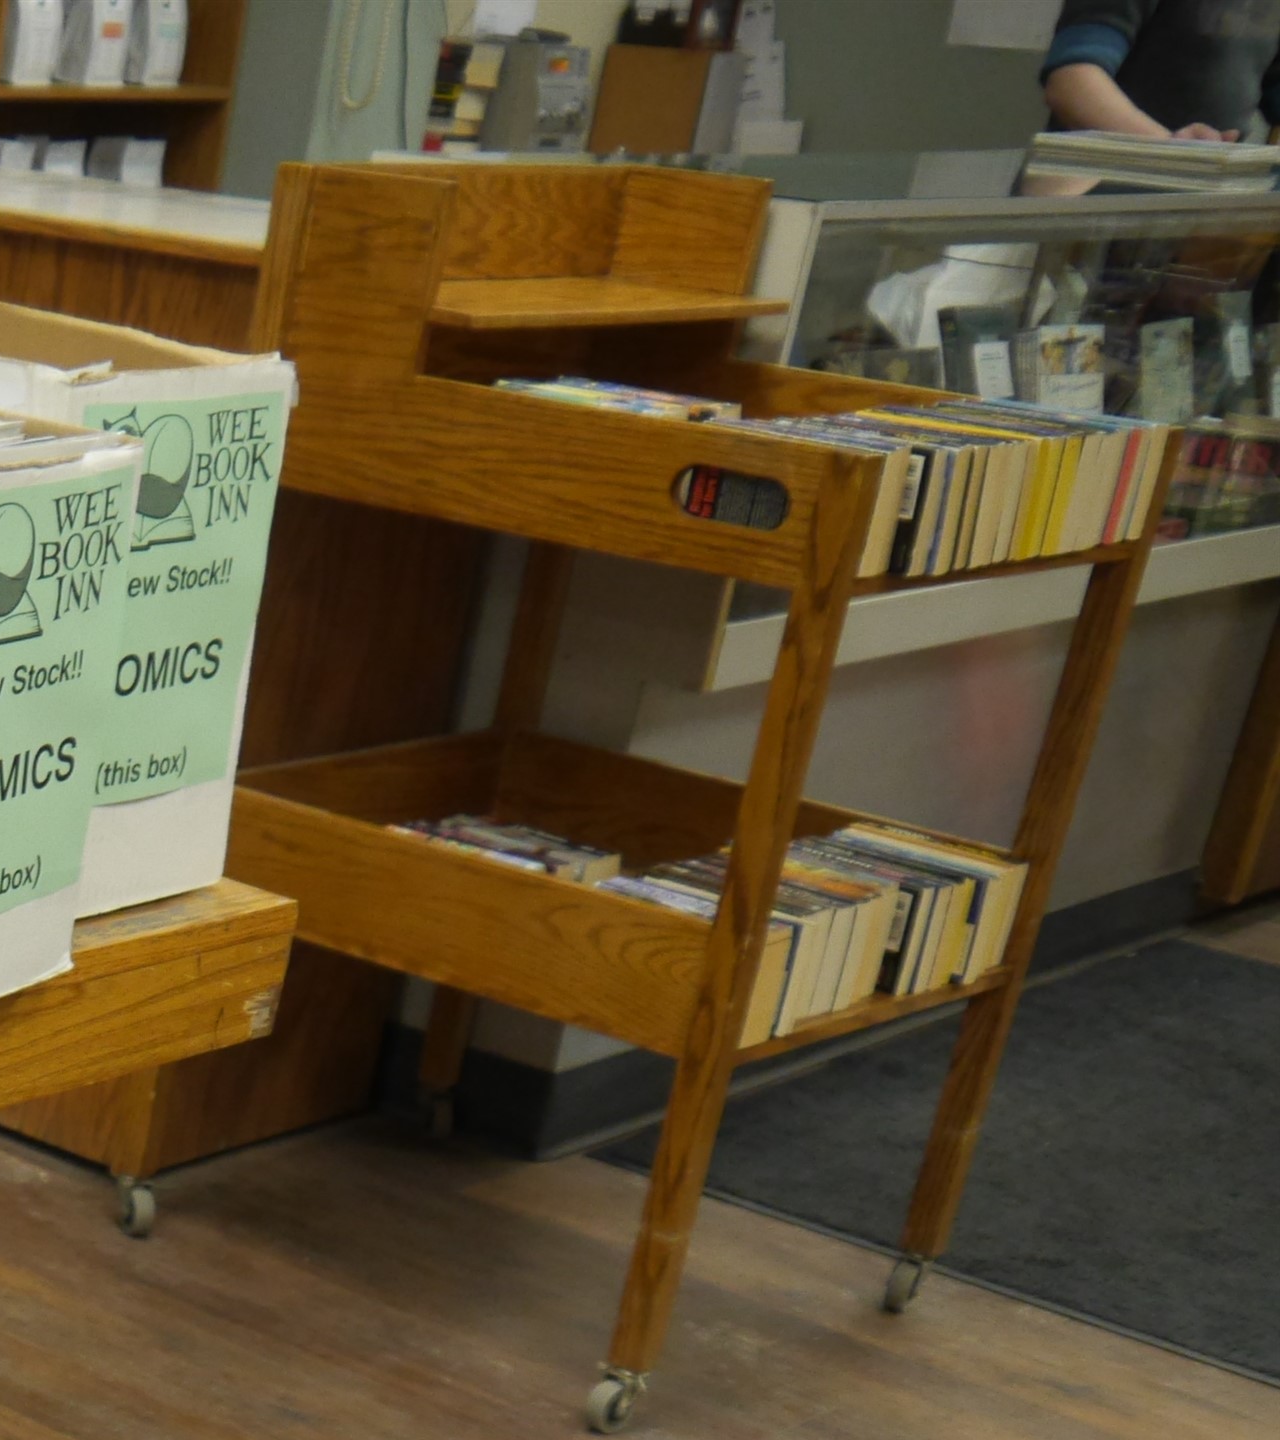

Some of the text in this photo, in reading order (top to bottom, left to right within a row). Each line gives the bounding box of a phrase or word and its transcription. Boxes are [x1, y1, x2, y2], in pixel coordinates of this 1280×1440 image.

[206, 406, 270, 447] WEE
[193, 442, 274, 488] BOOK
[52, 483, 122, 535] WEE
[205, 485, 251, 527] INN
[37, 522, 124, 581] BOOK
[52, 570, 106, 622] INN
[127, 557, 233, 600] ew Stock!!
[10, 649, 85, 696] Stock!!
[114, 638, 224, 698] OMICS
[94, 745, 188, 795] (this box)
[0, 854, 42, 897] box)
